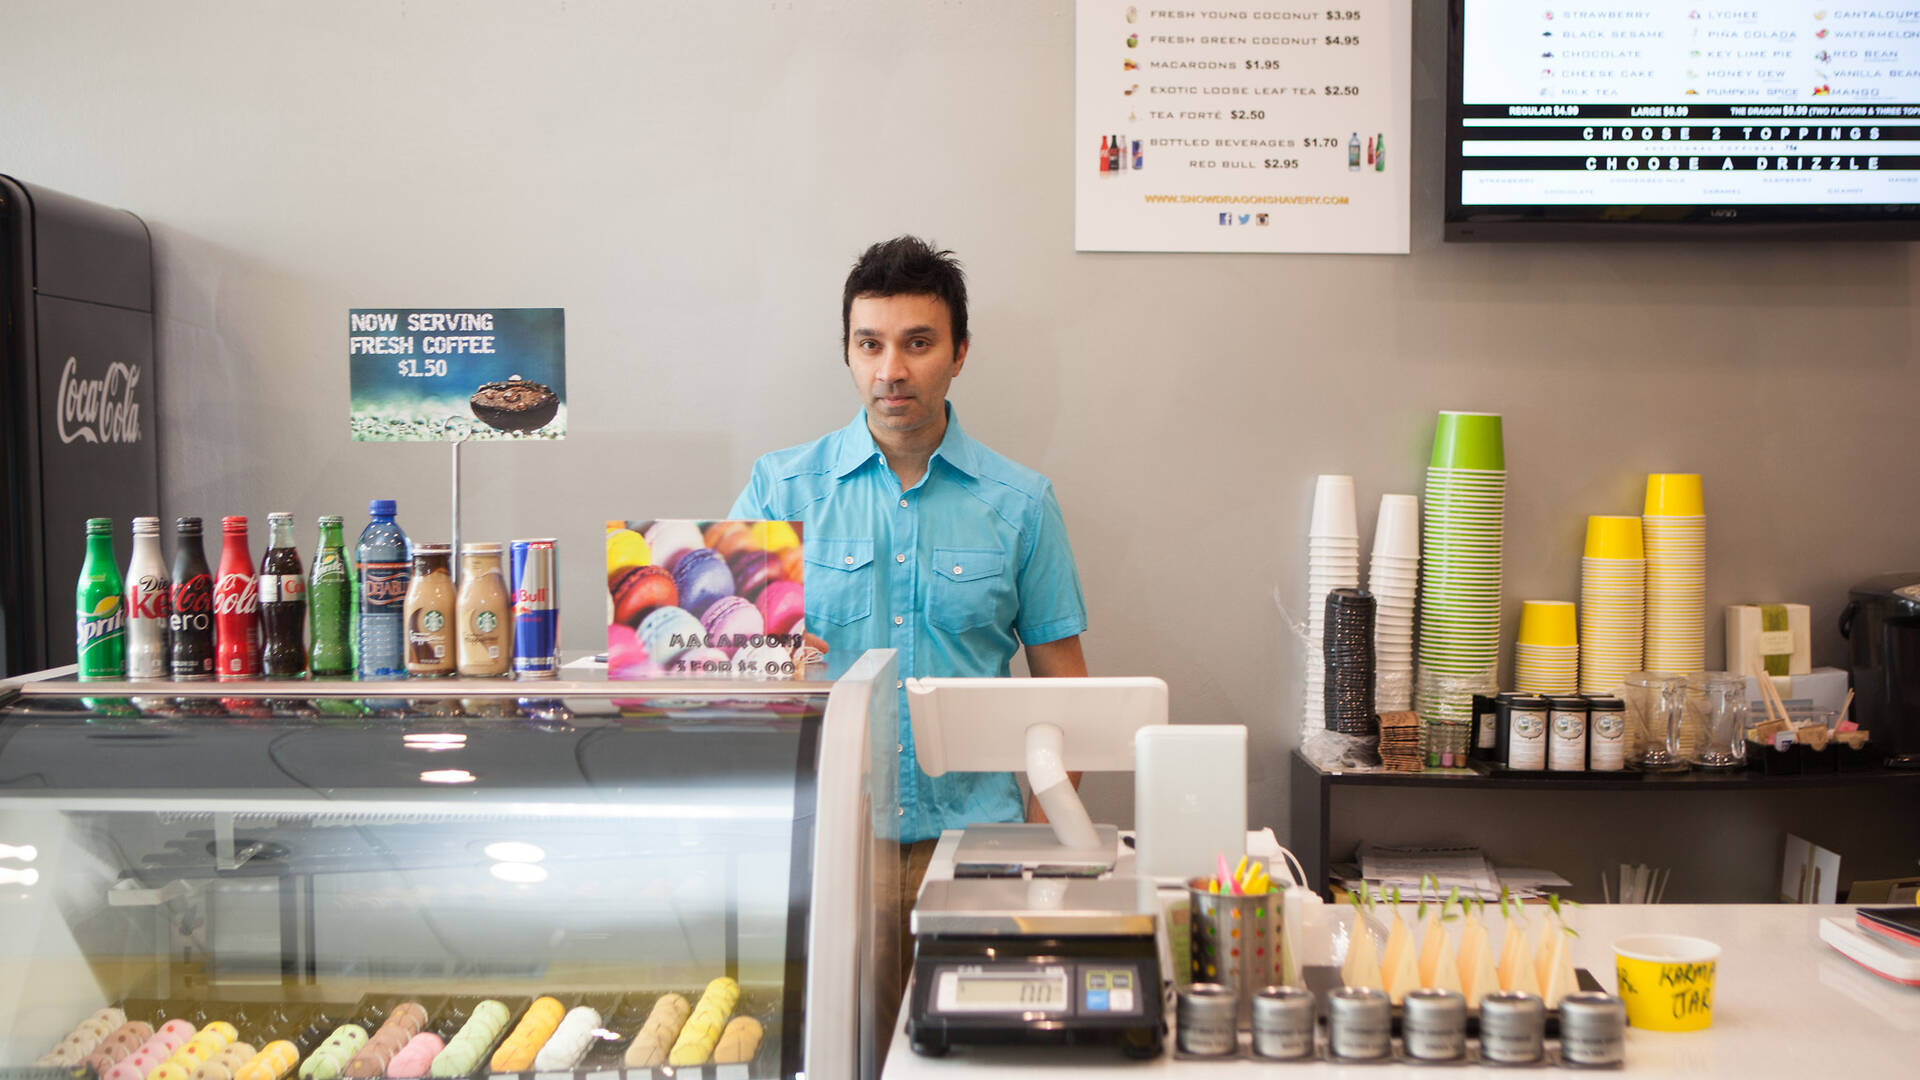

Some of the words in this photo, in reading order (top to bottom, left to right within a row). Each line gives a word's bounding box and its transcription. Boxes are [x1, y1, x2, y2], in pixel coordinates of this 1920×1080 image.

[1150, 10, 1196, 20] FRESH
[1200, 10, 1248, 20] YOUNG
[1252, 11, 1319, 20] COCONUT
[1325, 9, 1361, 21] $3.95
[1562, 11, 1652, 19] STRAWBERRY
[1707, 10, 1760, 19] LYCHEE
[1562, 30, 1606, 39] BLACK
[1610, 31, 1666, 39] SESAME
[1743, 30, 1798, 39] COLADA
[1150, 35, 1195, 45] FRESH
[1200, 35, 1247, 45] GREEN
[1252, 36, 1318, 46] COCONUT
[1325, 35, 1360, 47] $4.95
[1561, 50, 1642, 59] CHOCOLATE
[1707, 50, 1733, 59] KEY
[1737, 50, 1768, 59] LIME
[1772, 50, 1794, 59] PIE
[1864, 50, 1899, 59] BEAN
[1150, 60, 1237, 70] MACAROONS
[1245, 59, 1280, 71] $1.95
[1561, 70, 1615, 78] CHEESE
[1620, 70, 1656, 78] CAKE
[1706, 70, 1753, 78] HONEY
[1757, 70, 1787, 78] DEW
[1832, 70, 1883, 78] VANILLA
[1150, 85, 1198, 95] EXOTIC
[1203, 86, 1250, 96] LOOSE
[1255, 86, 1288, 96] LEAF
[1293, 86, 1317, 96] TEA
[1325, 84, 1360, 97] $2.50
[1561, 88, 1591, 96] MILK
[1596, 88, 1619, 96] TEA
[1705, 88, 1760, 97] PUMPKIN
[1766, 88, 1800, 97] SPICE
[1830, 88, 1881, 97] MANGO
[1150, 110, 1174, 120] TEA
[1230, 109, 1266, 121] $2.50
[1508, 105, 1553, 116] REGULAR
[1630, 107, 1663, 117] LARGE
[1730, 107, 1746, 117] THE
[1746, 107, 1782, 117] DRAGON
[1583, 126, 1690, 141] CHOOSE
[1712, 127, 1722, 141] 2
[1743, 127, 1880, 141] TOPPINGS
[1150, 138, 1210, 148] BOTTLED
[1215, 138, 1296, 148] BEVERAGES
[1303, 137, 1339, 149] $1.70
[1189, 159, 1217, 169] RED
[1222, 160, 1256, 169] BULL
[1264, 158, 1299, 170] $2.95
[1585, 156, 1700, 171] CHOOSE
[1721, 157, 1735, 171] A
[1756, 157, 1880, 171] DRIZZLE
[351, 312, 398, 332] NOW
[407, 312, 494, 332] SERVING
[350, 335, 414, 355] FRESH
[422, 335, 496, 354] COFFEE
[397, 358, 448, 378] $1.50
[57, 356, 141, 444] Coca-Cola
[669, 632, 803, 649] MACAROONS
[690, 660, 732, 673] FOR
